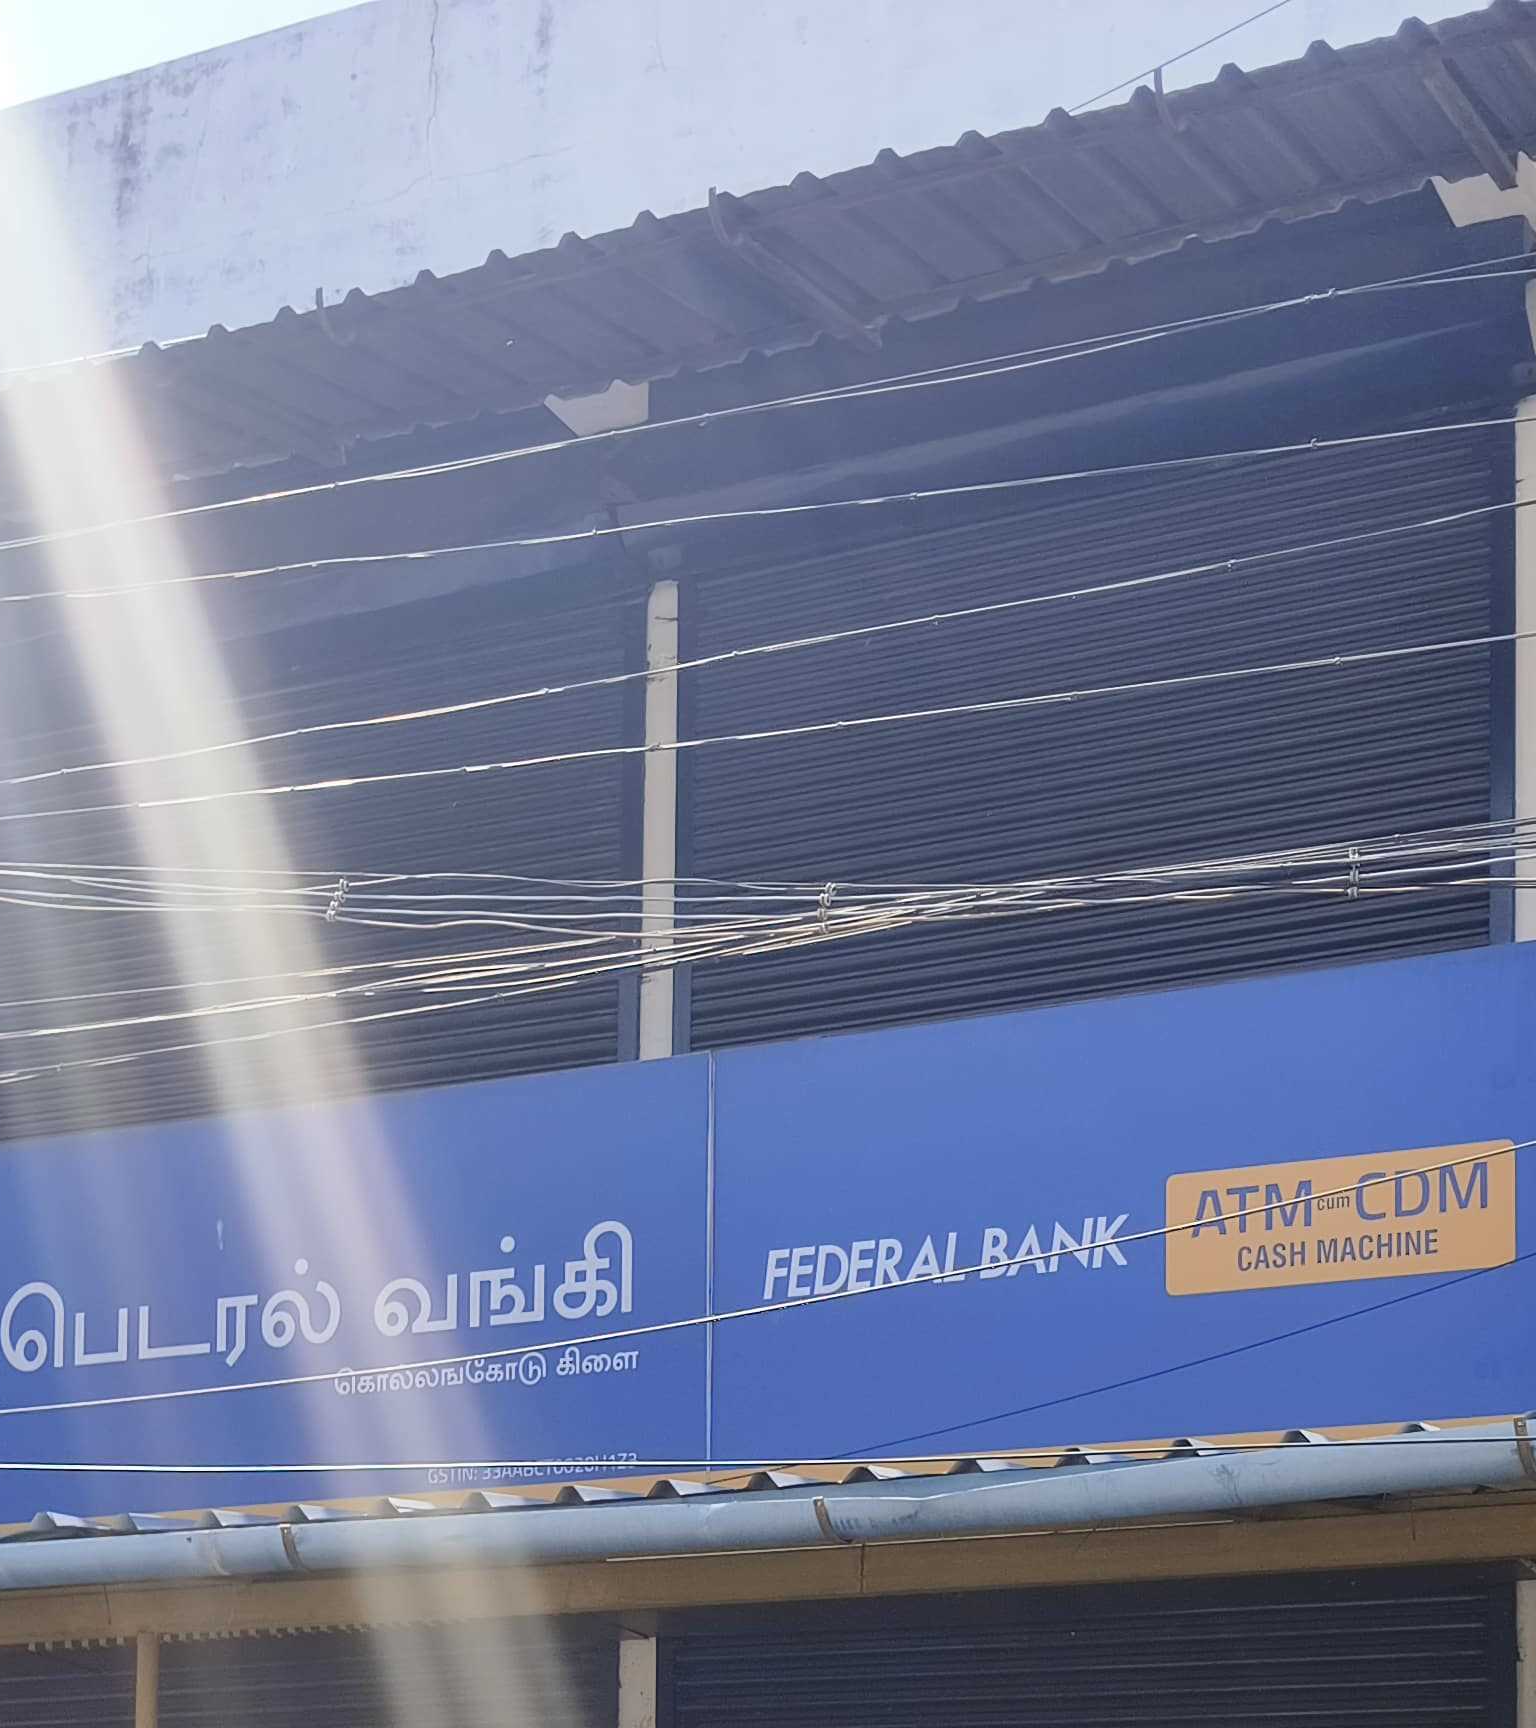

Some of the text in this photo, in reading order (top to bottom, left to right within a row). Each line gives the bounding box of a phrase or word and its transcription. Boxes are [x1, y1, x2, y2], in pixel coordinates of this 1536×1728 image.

[1192, 1161, 1489, 1238] ATM cum CDM
[762, 1213, 1130, 1300] FEDERAL BANK
[1238, 1228, 1439, 1272] CASH MACHINE
[0, 1220, 633, 1372] பெடரல் வங்கி
[556, 1346, 640, 1377] கிளை
[427, 1464, 478, 1485] GSTIN:
